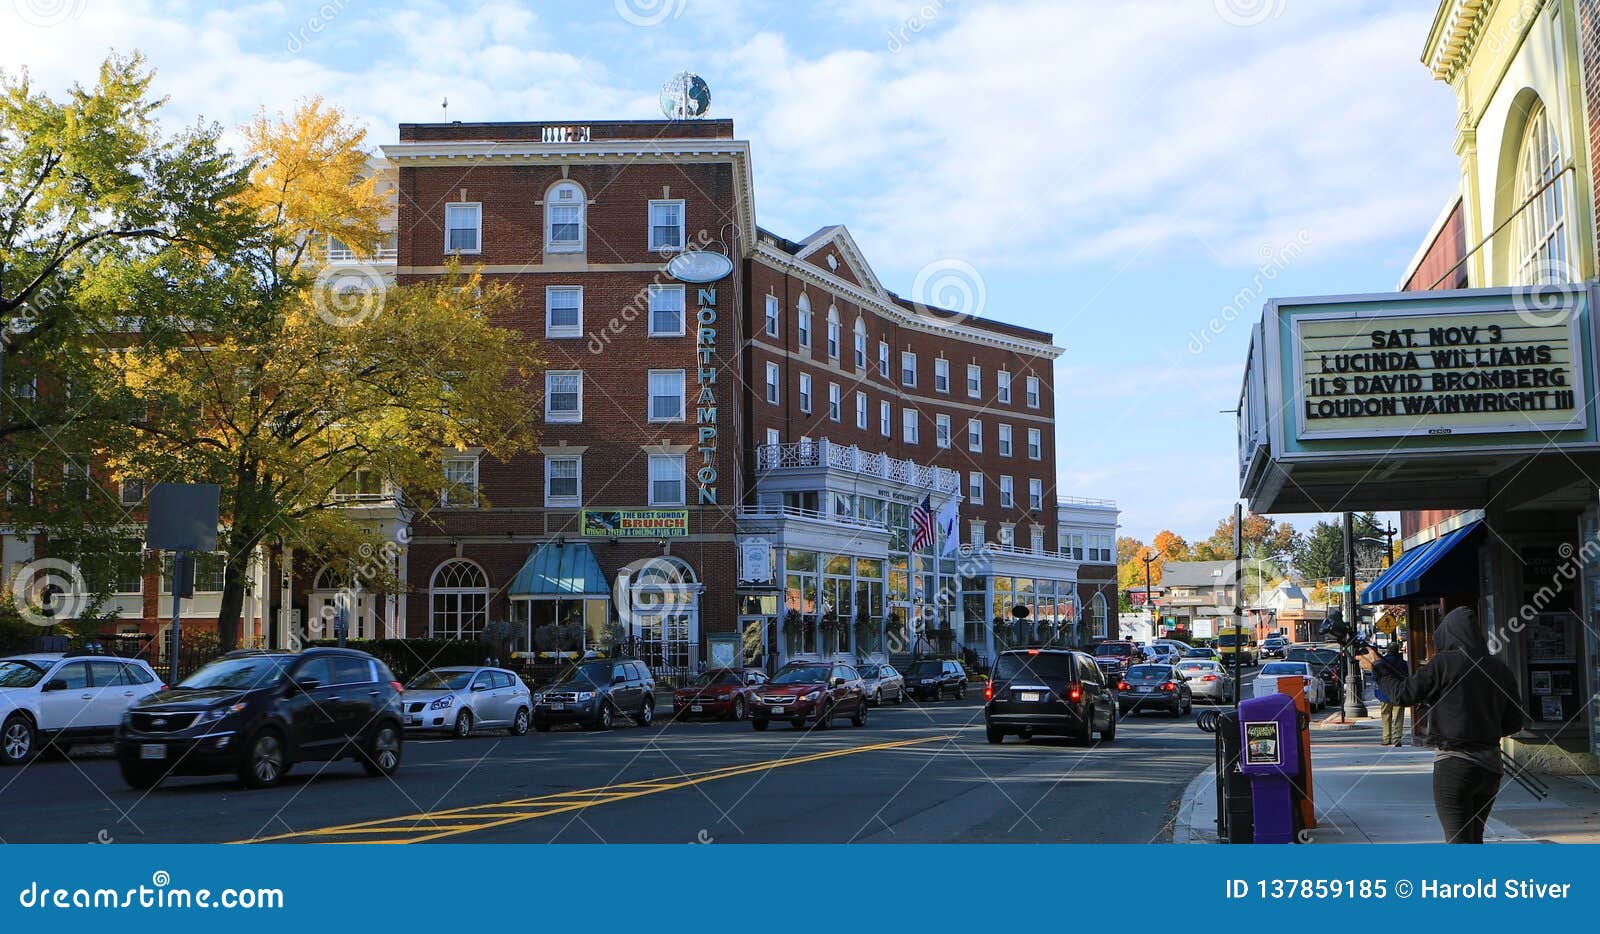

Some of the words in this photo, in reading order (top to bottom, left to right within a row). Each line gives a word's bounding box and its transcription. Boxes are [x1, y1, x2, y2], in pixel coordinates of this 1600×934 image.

[1371, 329, 1418, 348] SAT.
[1429, 327, 1481, 347] NOV.
[1488, 325, 1502, 344] 3
[1321, 351, 1419, 374] LUCINDA
[1430, 345, 1552, 369] WILLIAMS
[1354, 374, 1423, 394] DAVID
[1432, 368, 1565, 392] BROMBERG
[697, 288, 717, 504] NORTHAMPTON
[1305, 397, 1396, 420] LOUDON
[1401, 391, 1549, 415] WAINWRIGHT
[1555, 390, 1574, 410] III
[622, 519, 685, 528] BRUNCH
[656, 511, 685, 519] SUNDAY
